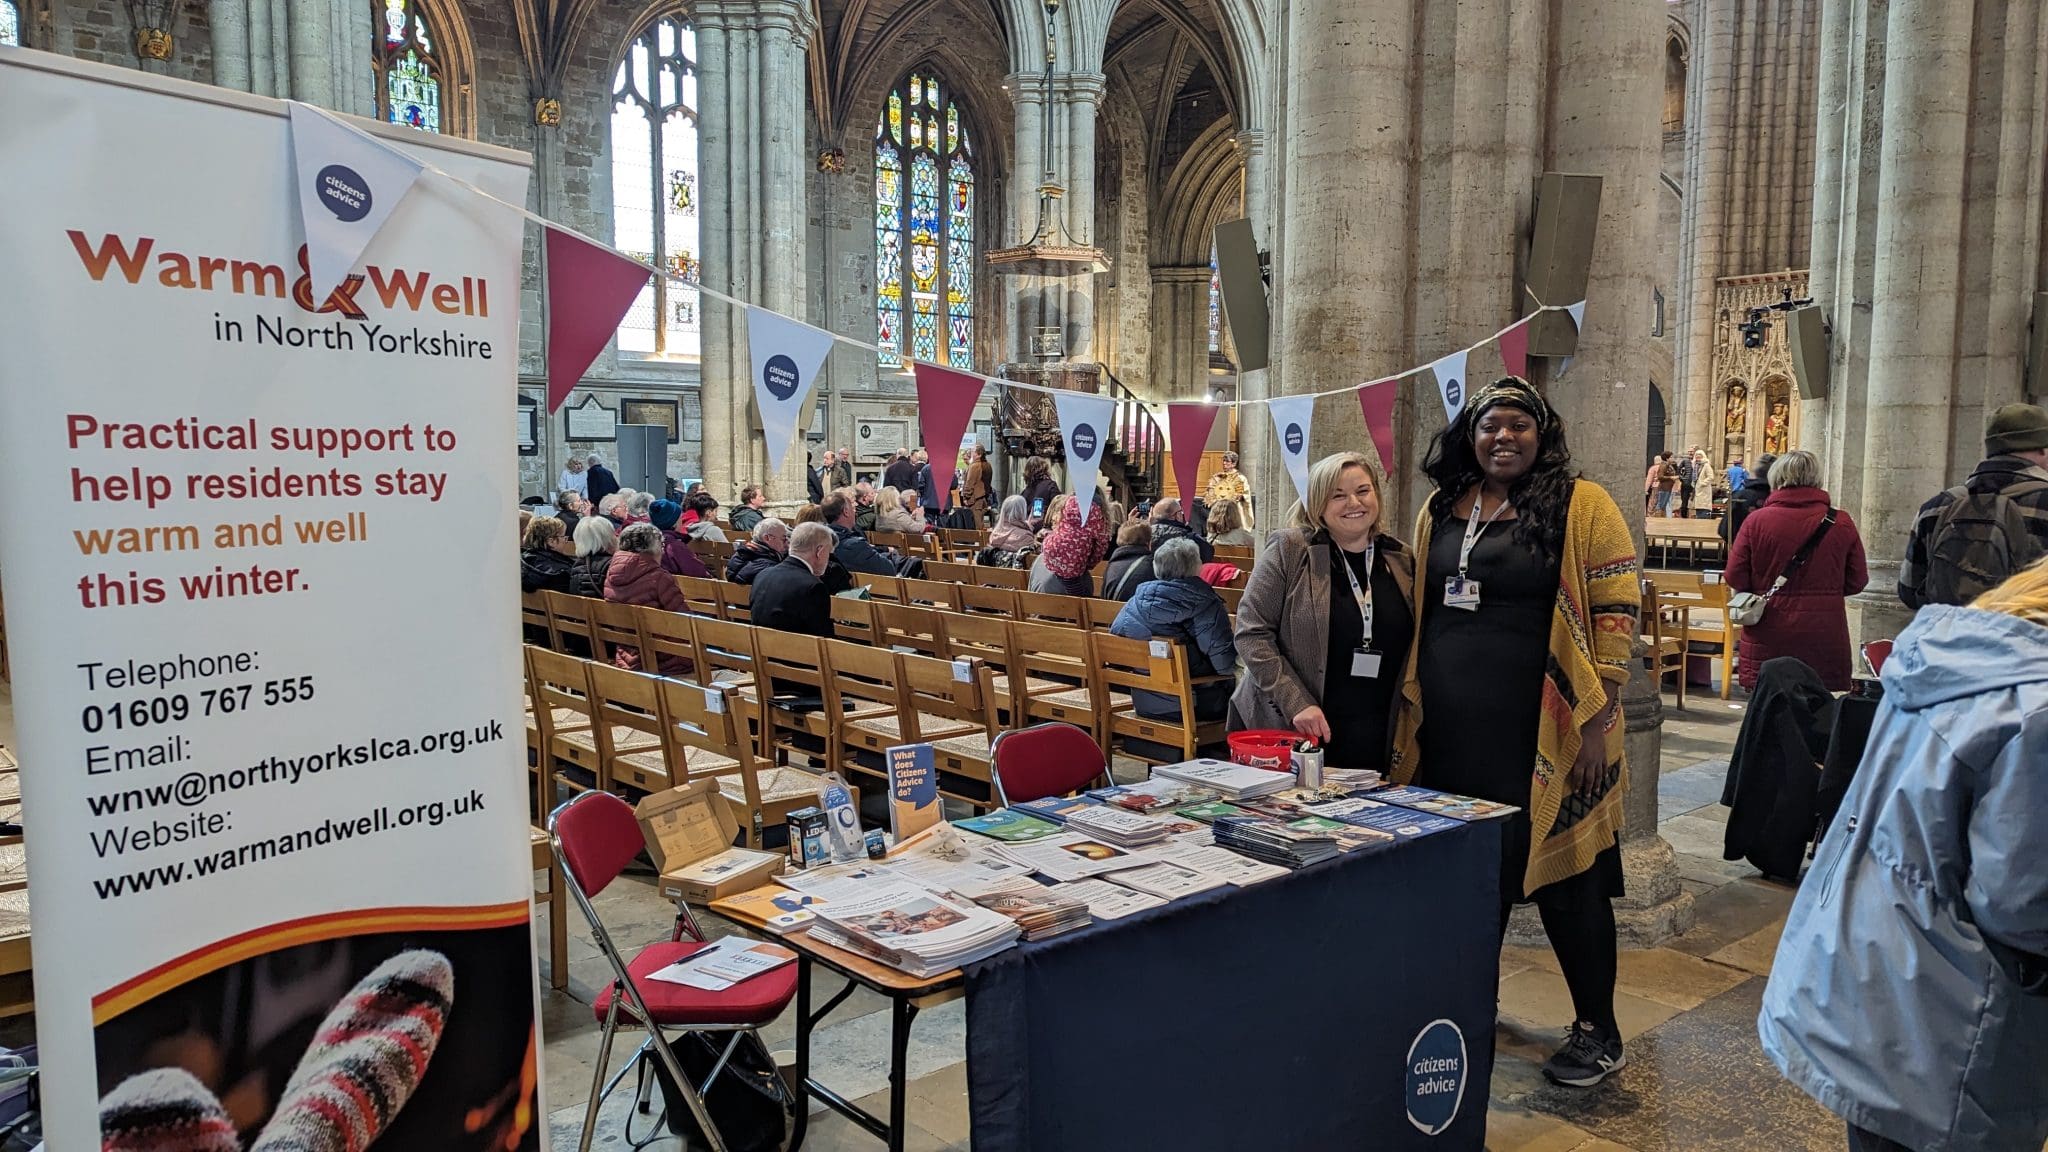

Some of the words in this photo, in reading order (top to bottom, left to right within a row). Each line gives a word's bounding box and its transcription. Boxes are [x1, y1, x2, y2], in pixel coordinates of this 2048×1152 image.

[325, 176, 367, 201] citizens
[325, 187, 361, 209] advice
[66, 229, 286, 299] Warm
[366, 265, 489, 318] Well
[214, 313, 243, 343] in
[256, 315, 354, 351] North
[362, 324, 493, 360] Yorkshire
[769, 365, 796, 380] citizens
[770, 375, 792, 388] advice
[66, 413, 258, 451] Practical
[270, 422, 414, 458] support
[424, 426, 457, 452] to
[71, 467, 172, 508] help
[186, 468, 363, 500] residents
[374, 468, 448, 501] stay
[73, 523, 200, 555] warm
[214, 515, 283, 549] and
[294, 512, 368, 544] well
[77, 571, 166, 609] this
[180, 564, 310, 600] winter.
[77, 648, 260, 691] Telephone:
[82, 694, 190, 733] 01609
[201, 684, 253, 717] 767
[263, 675, 315, 706] 555
[85, 736, 192, 776] Email:
[87, 718, 504, 817] wnw@northyorkslca.org.uk
[893, 751, 916, 761] What
[894, 760, 914, 770] does
[895, 767, 927, 779] Citizens
[896, 777, 923, 788] Advice
[897, 787, 912, 797] do?
[90, 805, 233, 858] Website:
[93, 788, 486, 900] www.warmandwell.org.uk
[1413, 1056, 1458, 1075] citizens
[1416, 1075, 1456, 1096] advice
